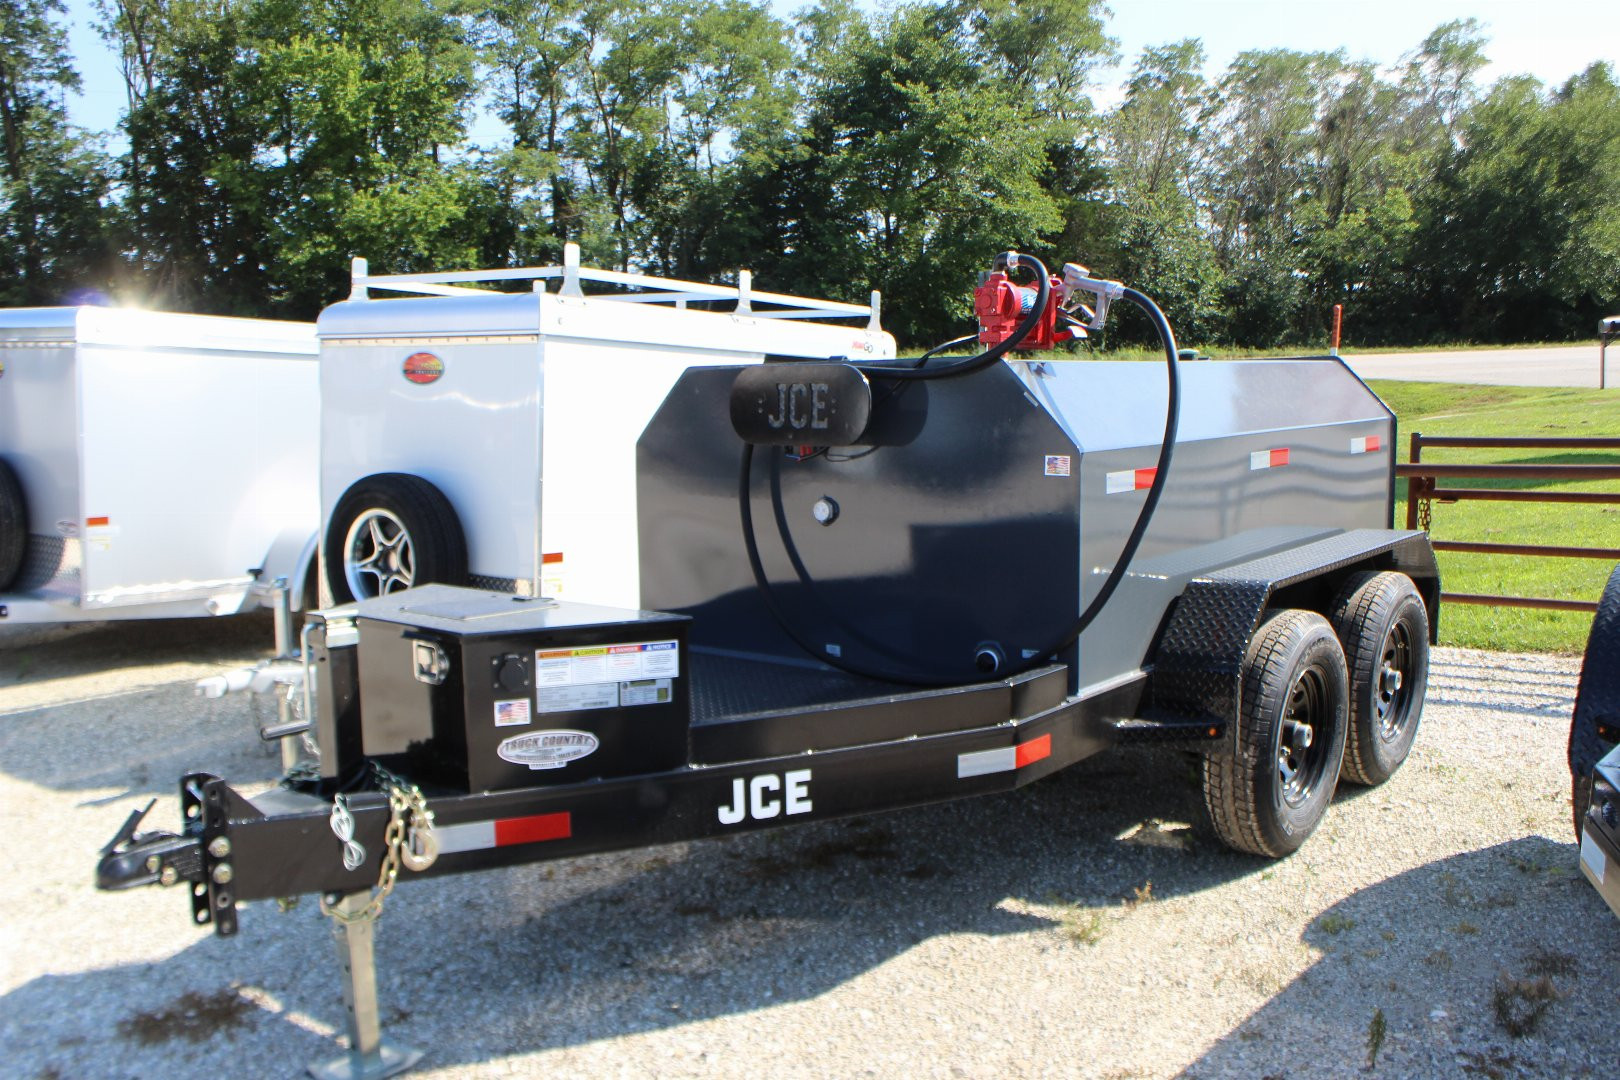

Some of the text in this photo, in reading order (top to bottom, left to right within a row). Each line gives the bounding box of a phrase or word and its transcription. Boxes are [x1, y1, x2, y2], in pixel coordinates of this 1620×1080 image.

[768, 383, 829, 430] JCE
[505, 735, 590, 751] TRUCK COUNTRY
[718, 769, 813, 825] JCE
